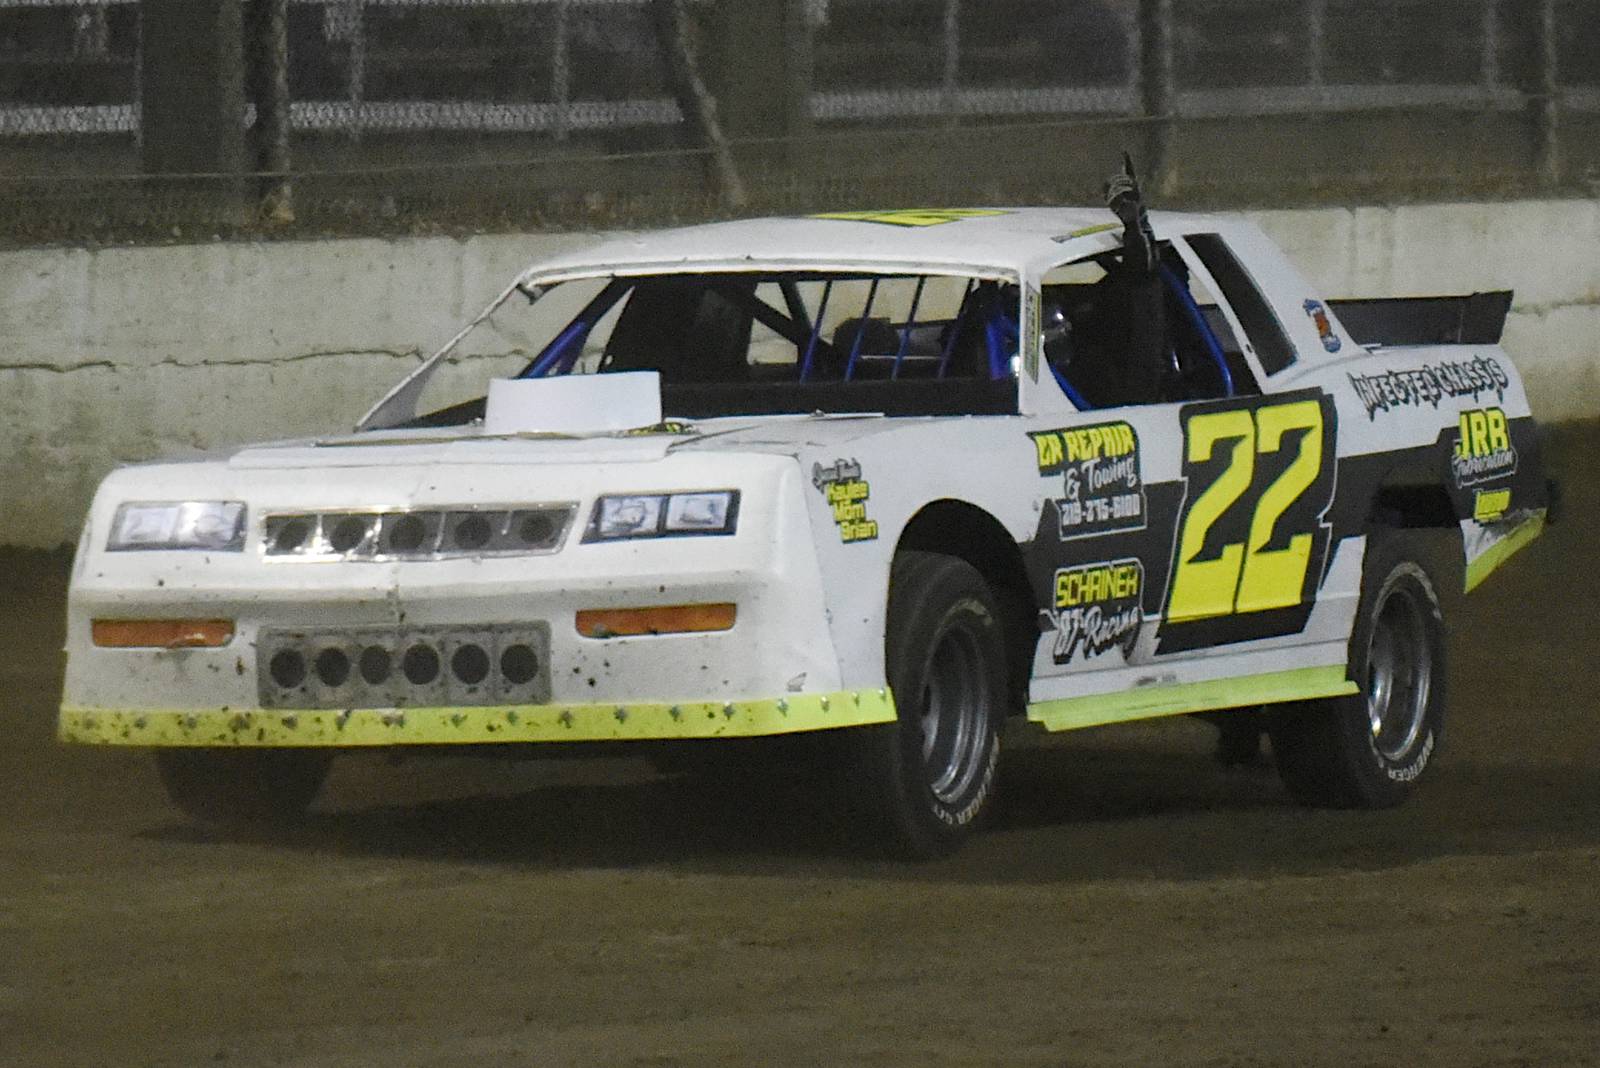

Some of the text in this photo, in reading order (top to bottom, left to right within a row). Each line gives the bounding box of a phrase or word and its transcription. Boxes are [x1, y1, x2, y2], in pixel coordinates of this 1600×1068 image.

[1063, 424, 1135, 462] REPAIR
[1455, 409, 1508, 460] JRB
[1081, 455, 1137, 492] Towing
[1167, 401, 1323, 623] 22
